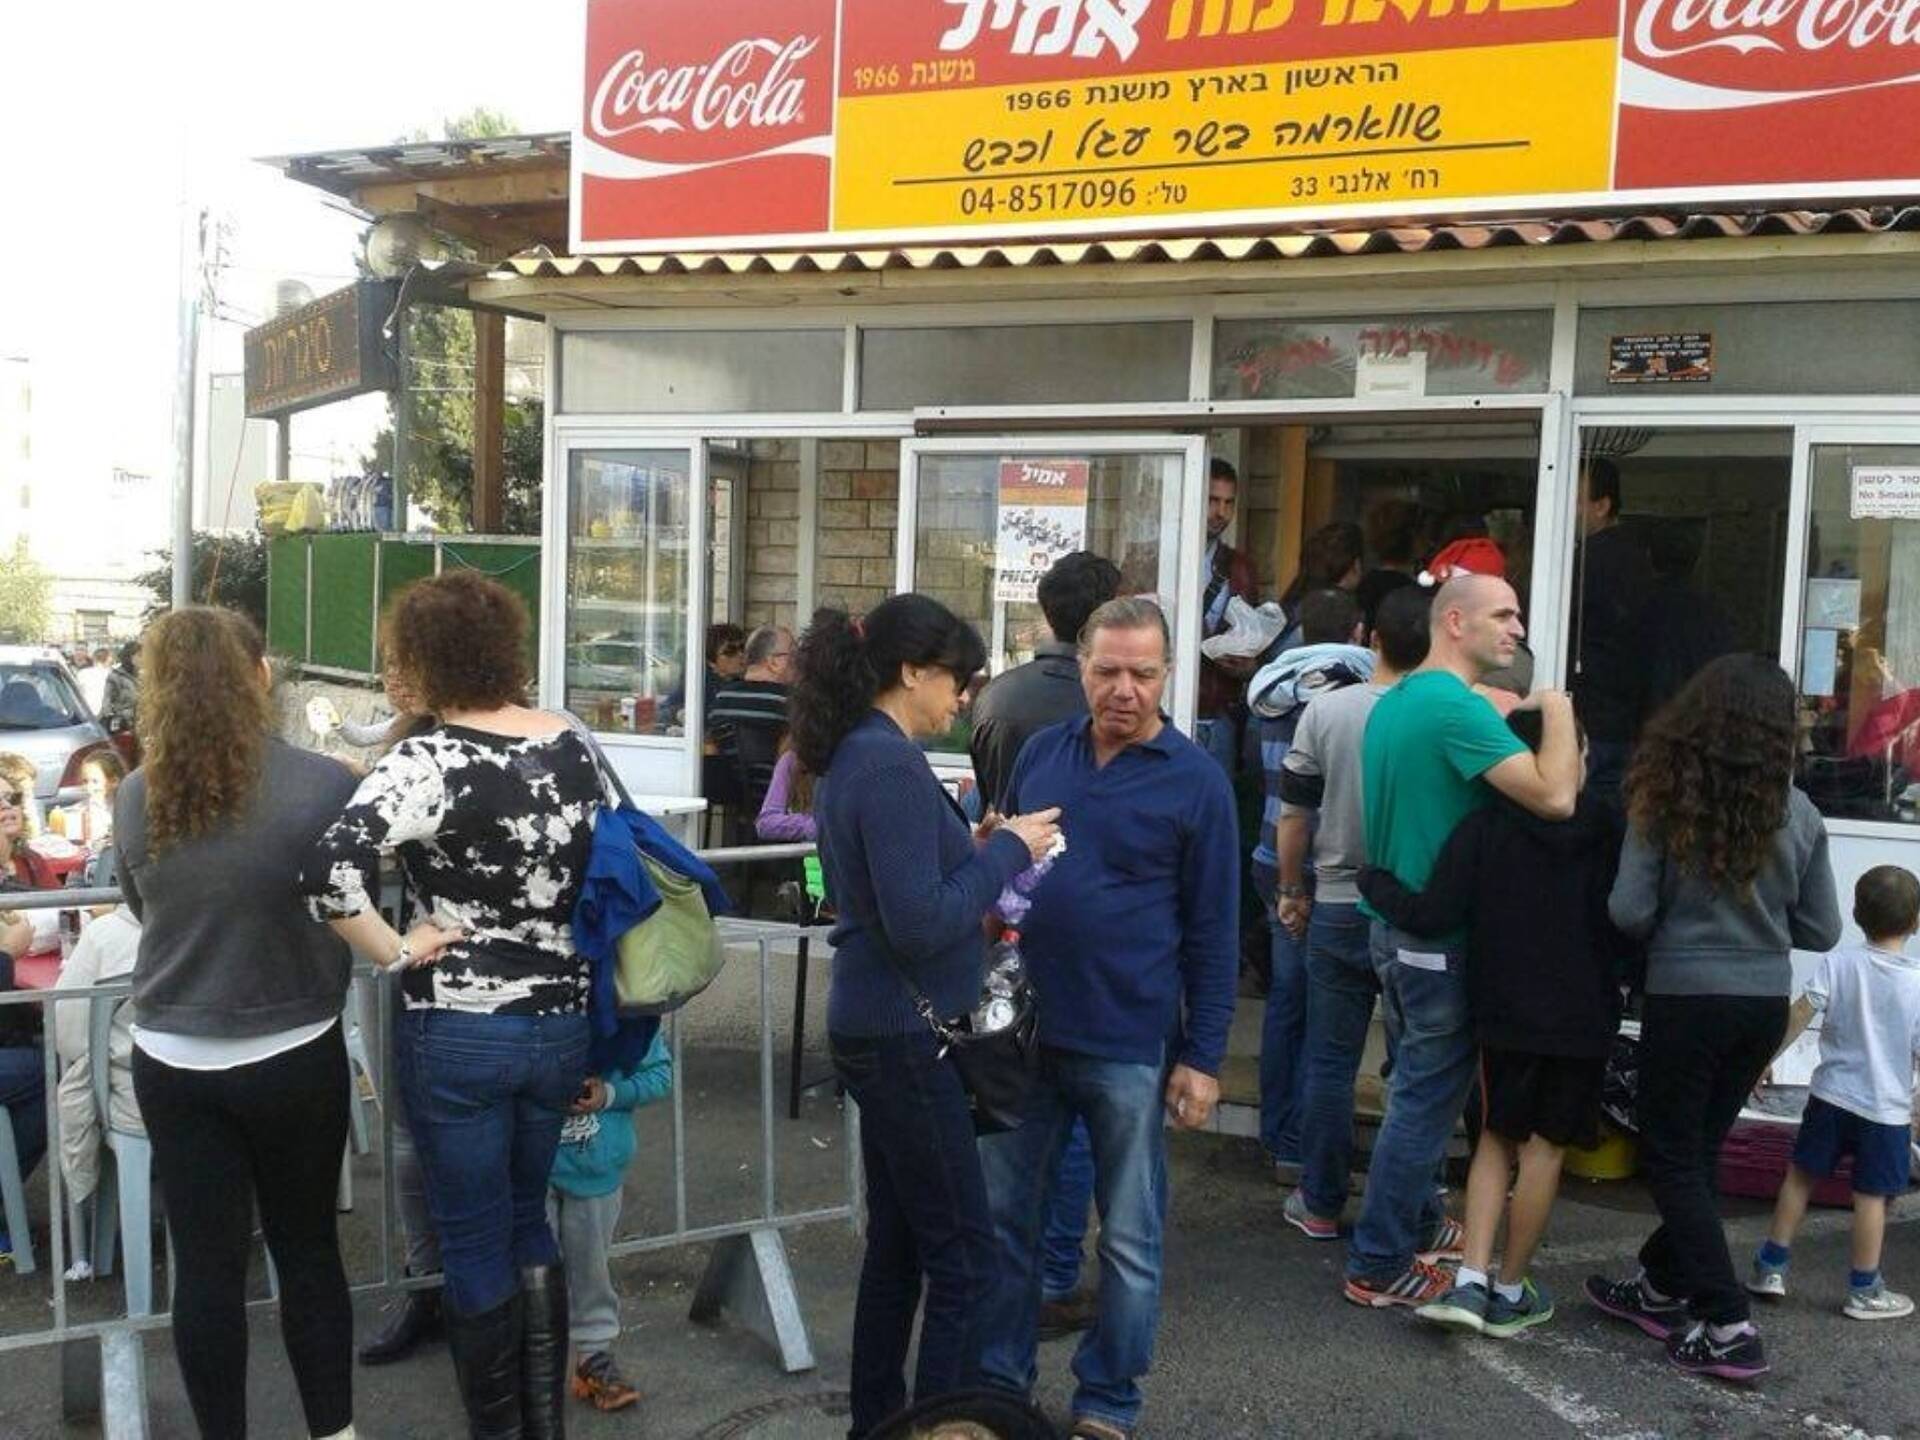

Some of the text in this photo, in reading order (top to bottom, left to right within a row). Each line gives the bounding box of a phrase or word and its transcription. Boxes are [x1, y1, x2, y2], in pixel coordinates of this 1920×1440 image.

[591, 35, 821, 138] Coca-Cola
[853, 58, 976, 90] משנת 1966
[1005, 61, 1399, 112] הראשון בארץ משנת 1966
[962, 102, 1441, 173] שווארמה בשר עגל וכבש
[960, 177, 1136, 216] 04-8517096
[1290, 166, 1440, 198] רח' אלנבי 33
